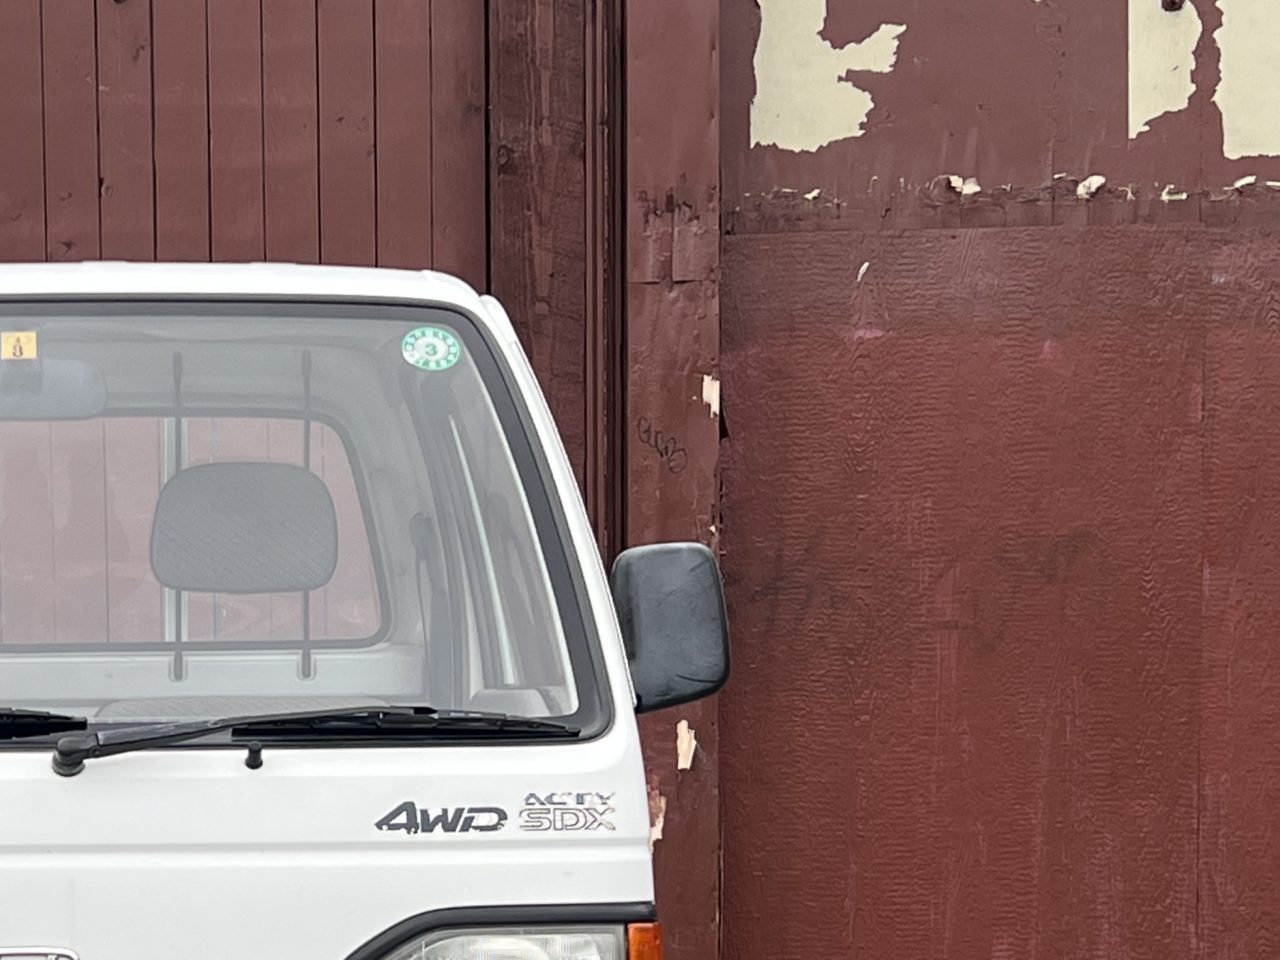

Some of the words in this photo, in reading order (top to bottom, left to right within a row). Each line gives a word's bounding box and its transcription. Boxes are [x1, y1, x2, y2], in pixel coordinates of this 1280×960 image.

[424, 343, 438, 357] 3
[374, 801, 508, 834] 4WD
[518, 807, 616, 831] SDX
